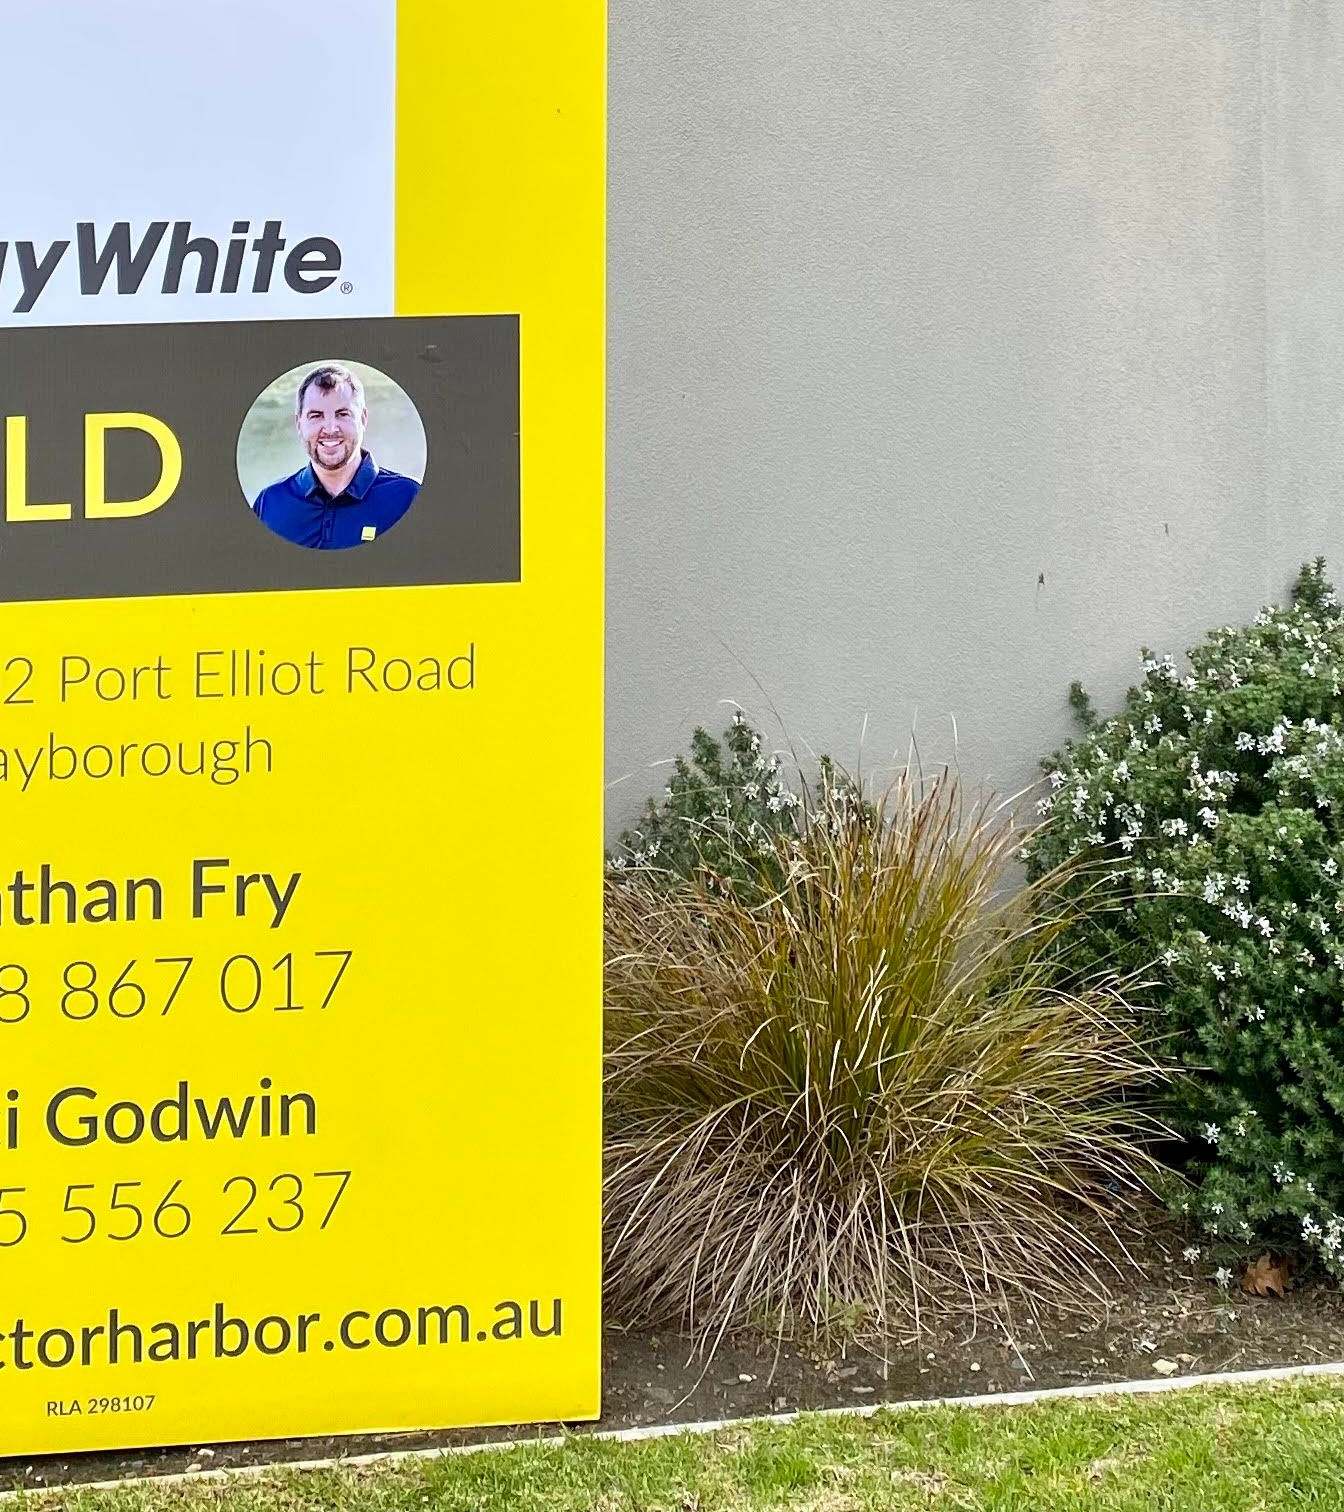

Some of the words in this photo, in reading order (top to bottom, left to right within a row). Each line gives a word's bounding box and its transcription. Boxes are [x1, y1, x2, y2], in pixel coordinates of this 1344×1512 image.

[61, 655, 172, 703] Port
[194, 648, 325, 699] Elliot
[347, 642, 476, 694] Road
[192, 858, 302, 929] Fry
[60, 956, 194, 1021] 867
[220, 950, 353, 1014] 017
[45, 1077, 316, 1147] Godwin
[60, 1179, 191, 1244] 556
[220, 1170, 352, 1236] 237
[47, 1399, 82, 1417] RLA
[87, 1394, 156, 1415] 298107
